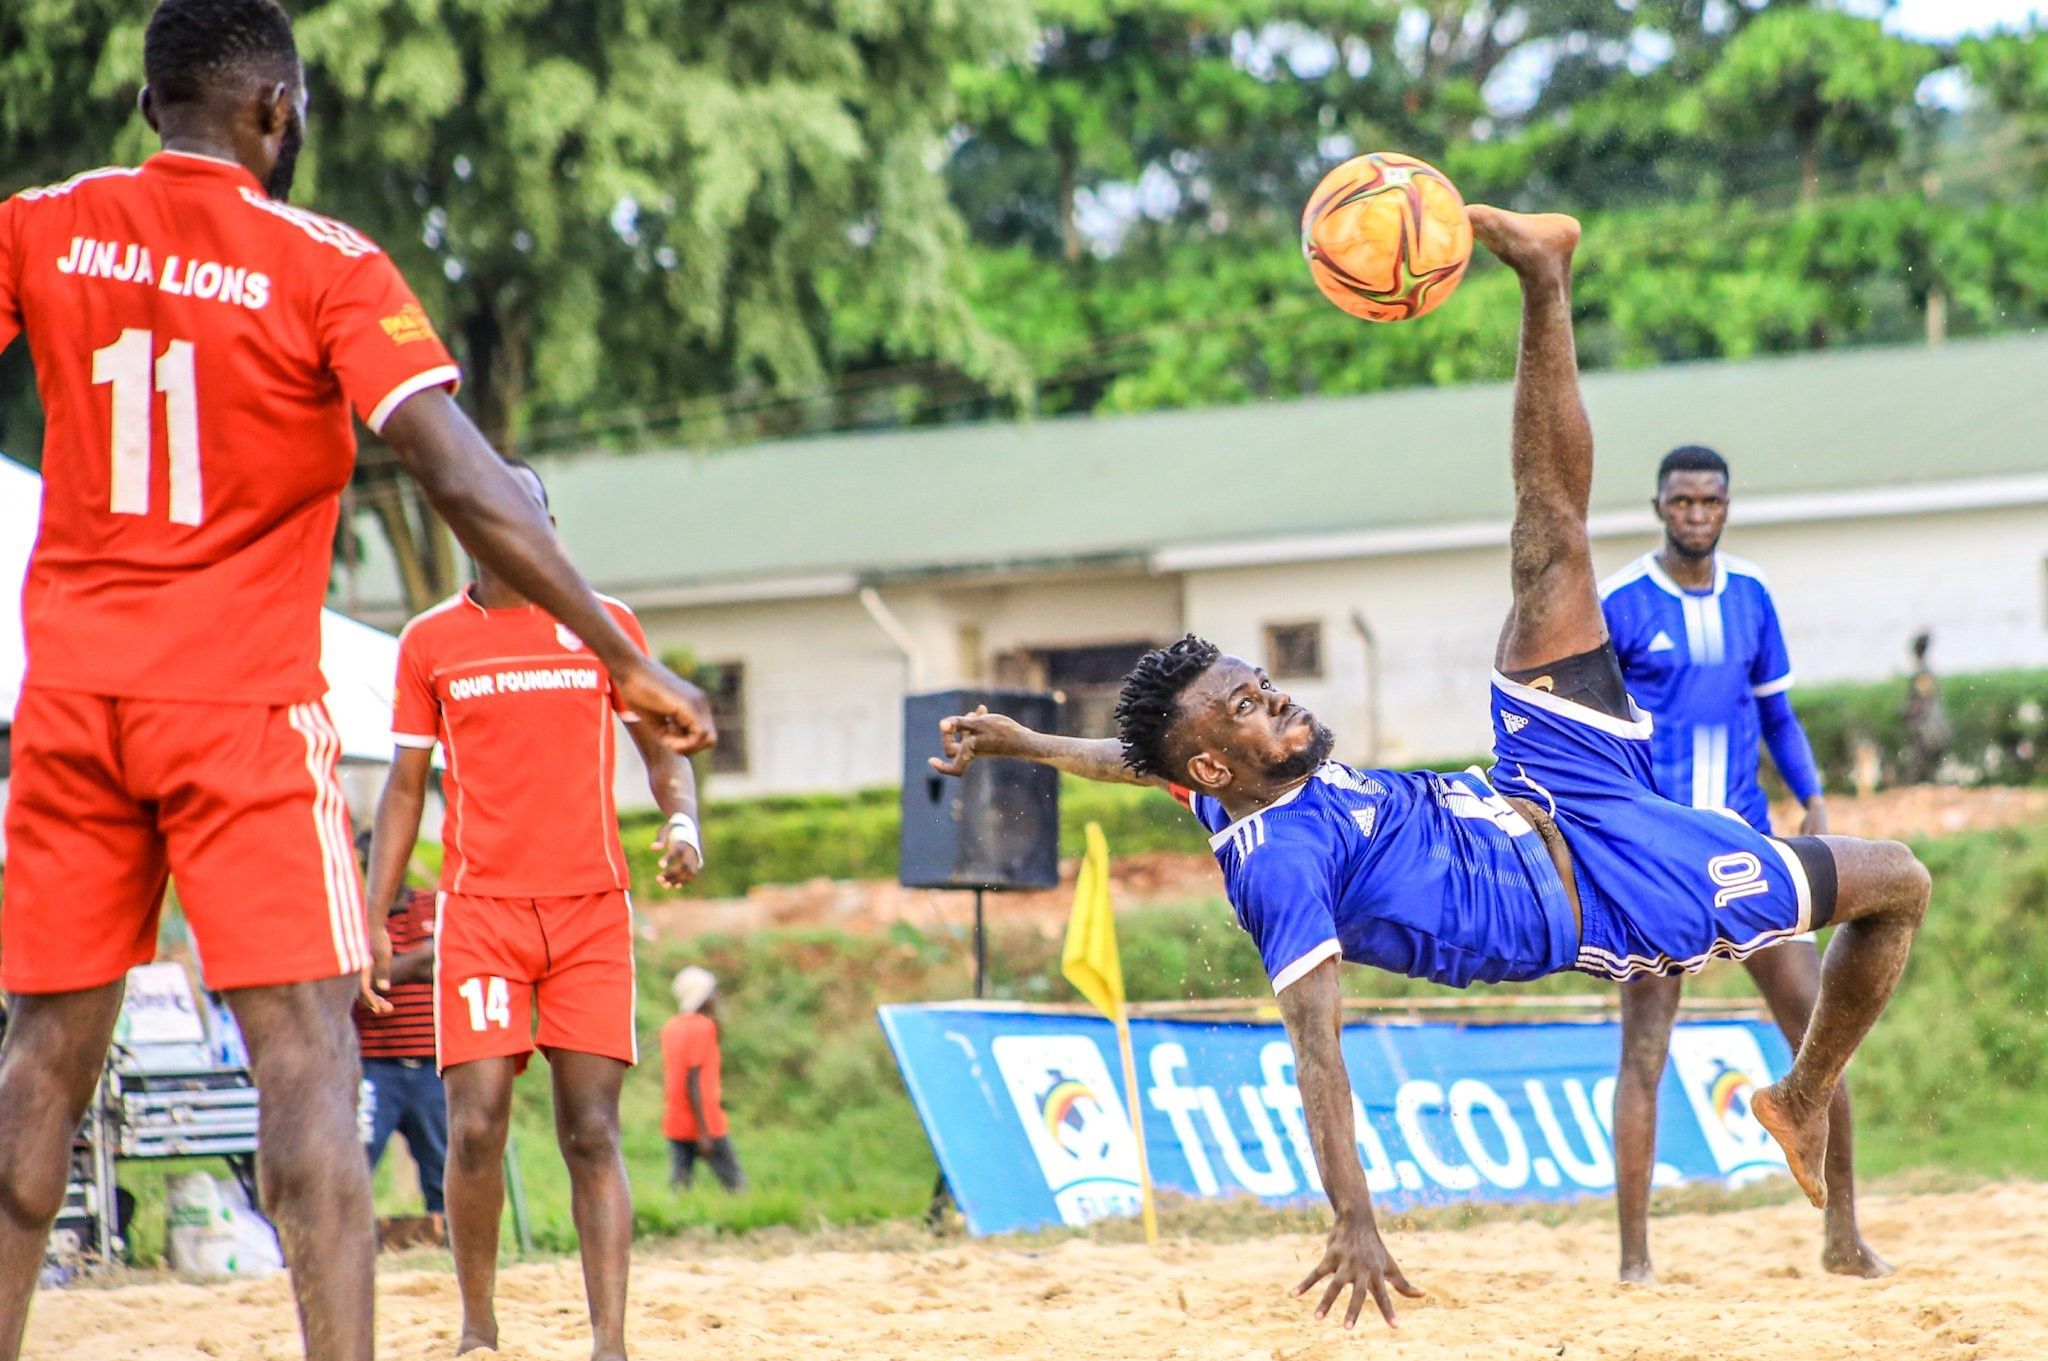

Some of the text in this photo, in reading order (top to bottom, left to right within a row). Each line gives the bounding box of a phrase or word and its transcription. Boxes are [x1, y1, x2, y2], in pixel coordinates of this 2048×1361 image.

[57, 237, 271, 309] JINJA LIONS
[92, 328, 203, 526] 11
[496, 669, 598, 693] FOUNDATION
[1708, 851, 1769, 908] 10
[458, 976, 510, 1031] 14
